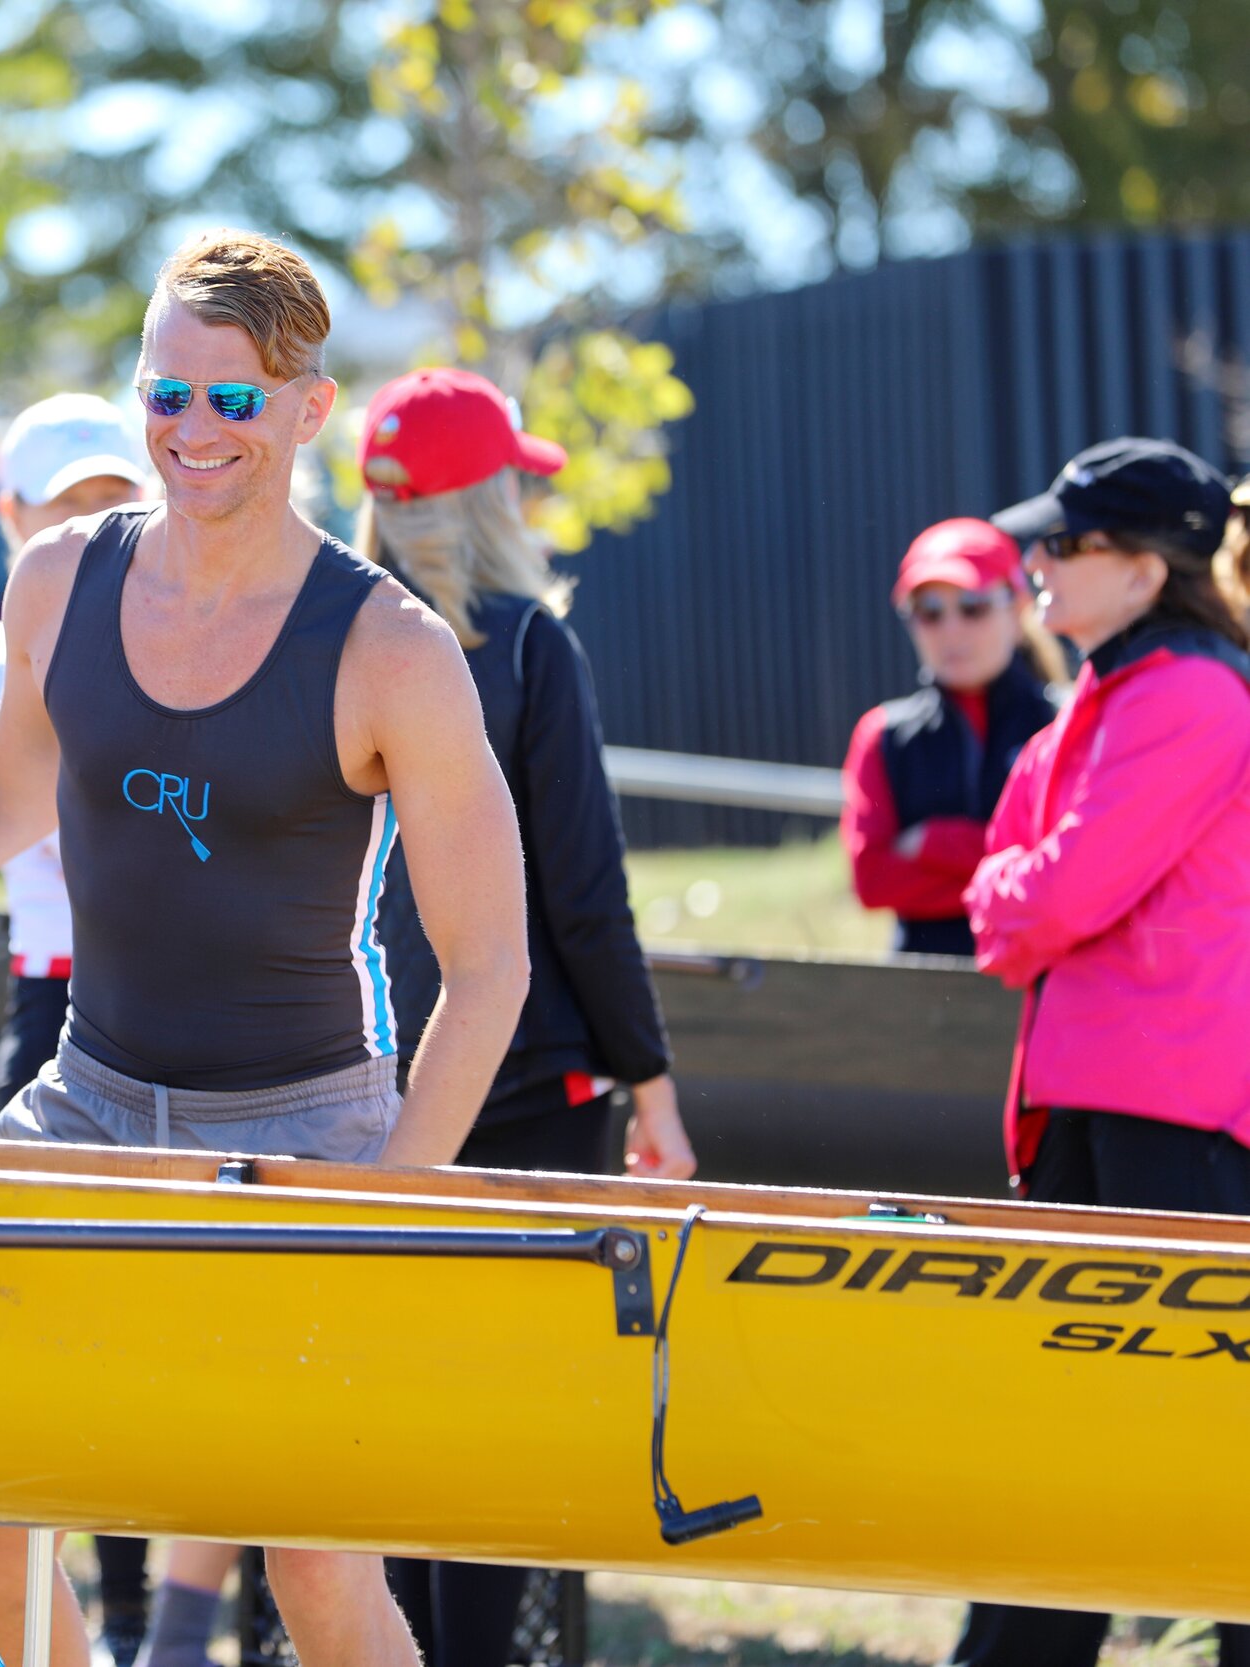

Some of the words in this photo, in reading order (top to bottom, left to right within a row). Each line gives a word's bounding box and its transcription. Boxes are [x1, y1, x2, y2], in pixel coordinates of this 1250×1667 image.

[122, 768, 212, 862] CRU
[725, 1241, 1250, 1311] DIRIGO
[1041, 1322, 1250, 1363] SLX
